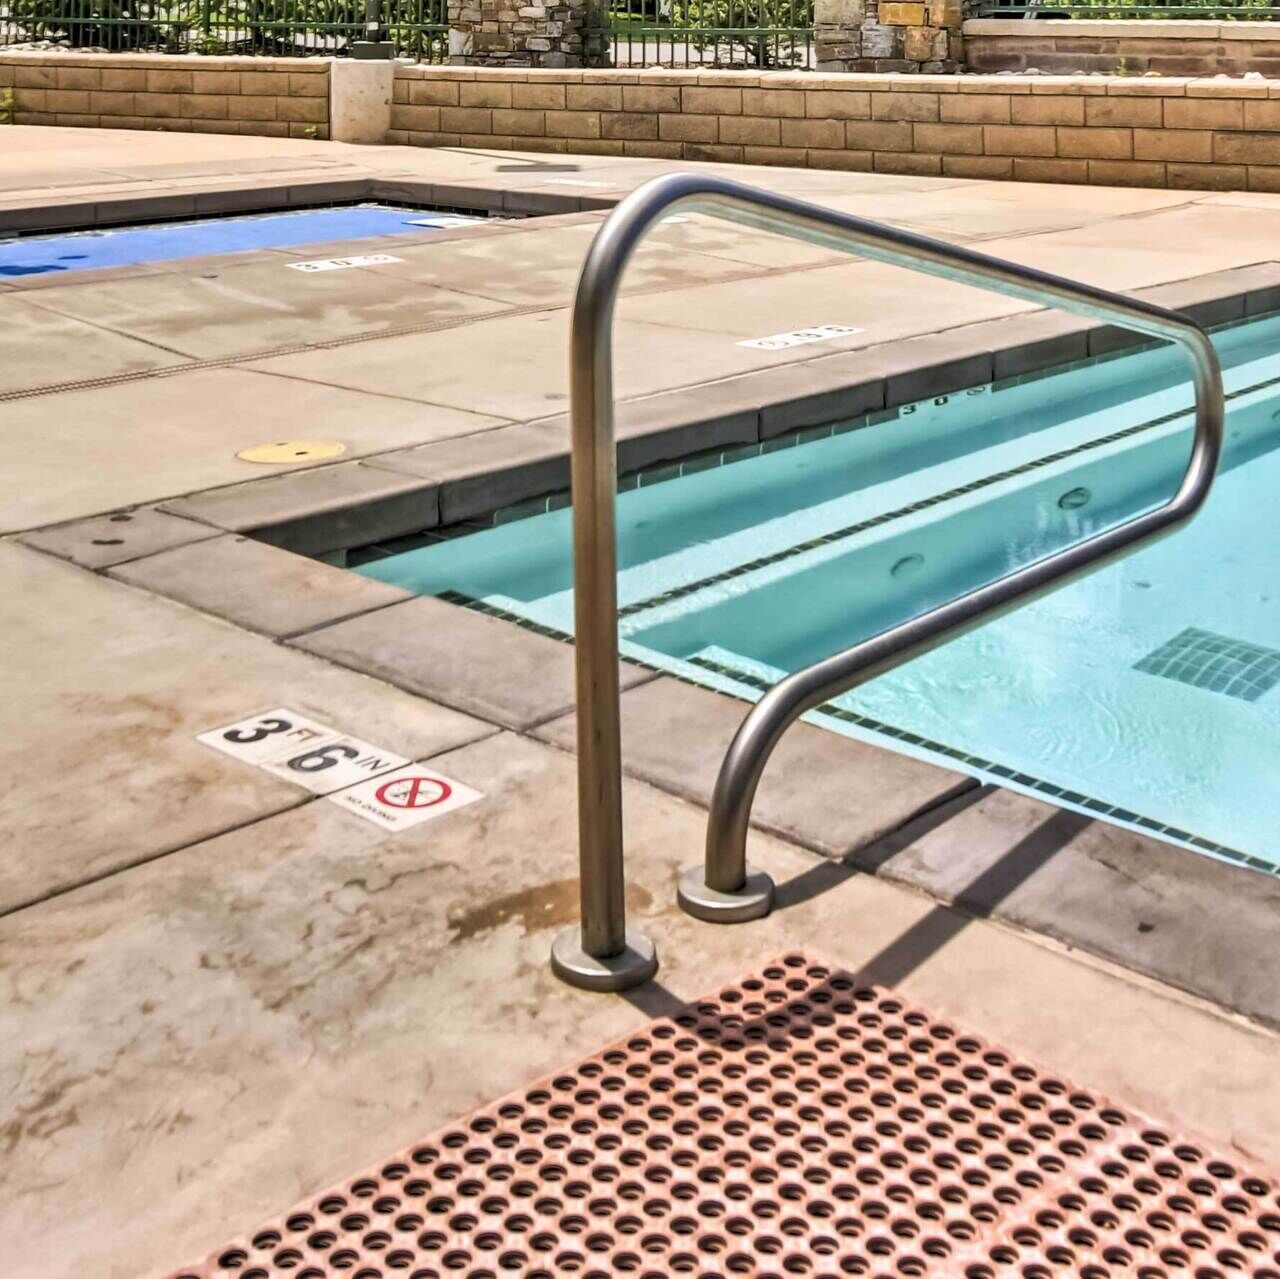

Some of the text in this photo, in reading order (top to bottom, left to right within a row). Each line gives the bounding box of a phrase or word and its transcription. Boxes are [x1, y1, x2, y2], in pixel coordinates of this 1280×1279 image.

[222, 718, 391, 772] 3 FT 6 IN
